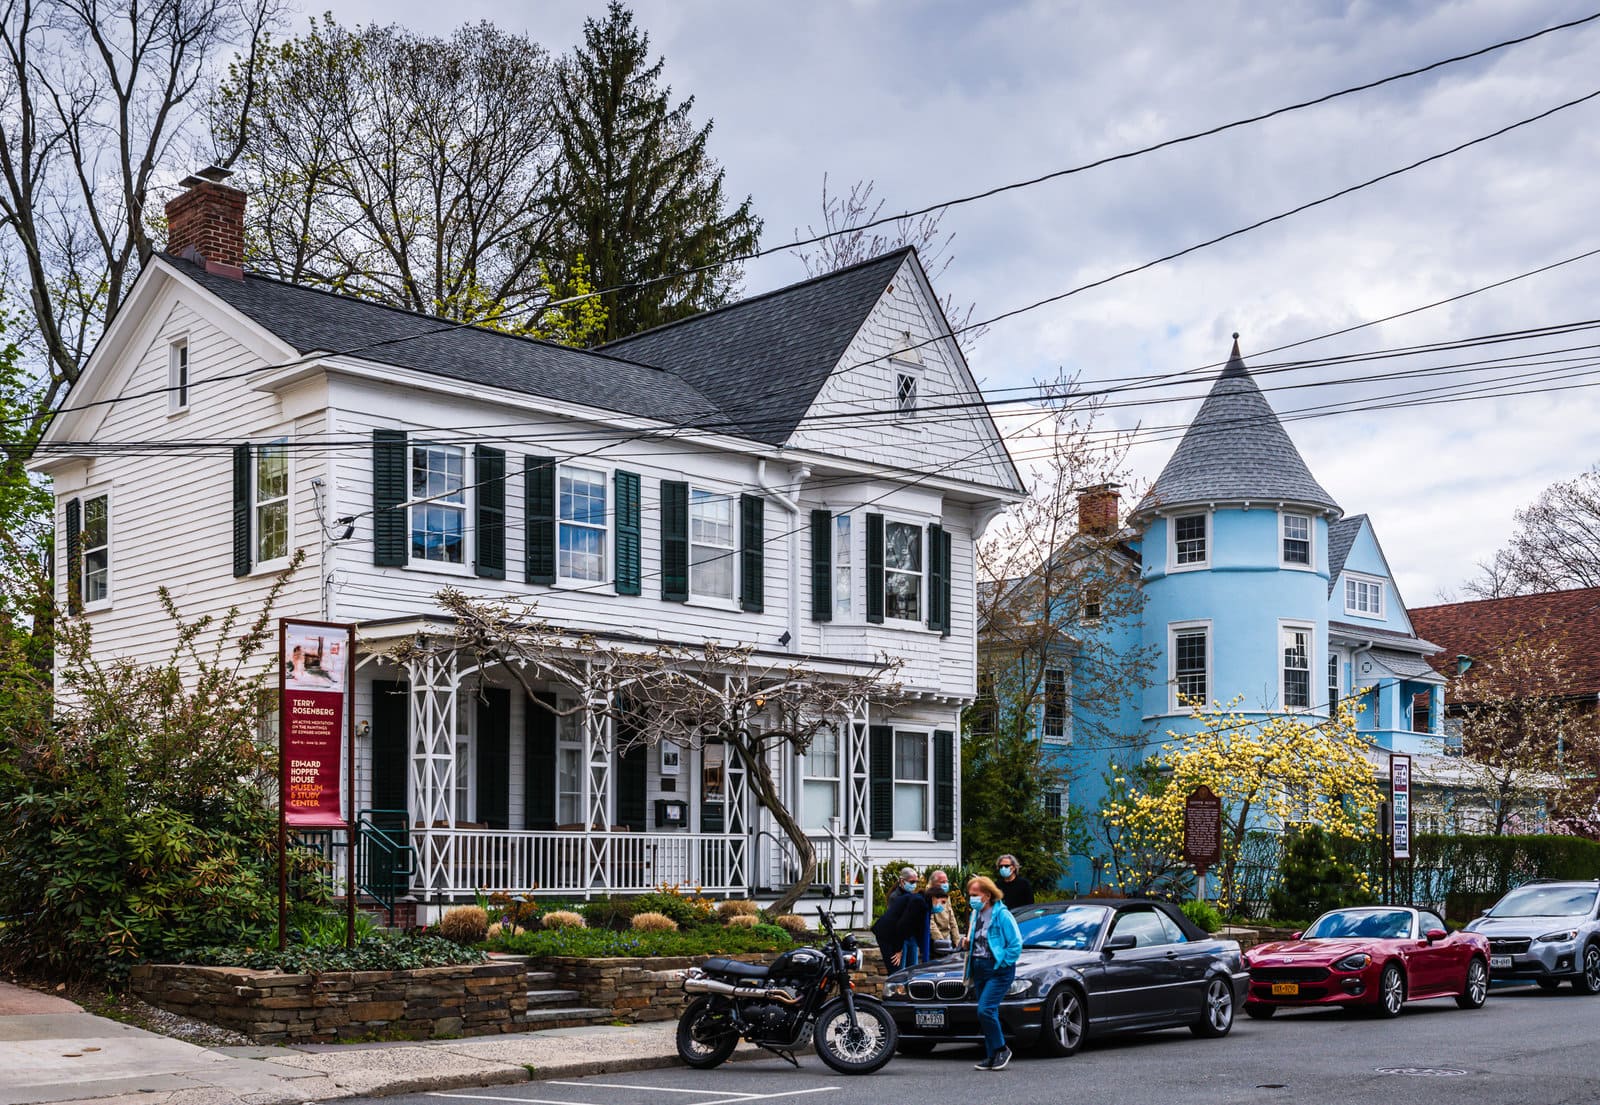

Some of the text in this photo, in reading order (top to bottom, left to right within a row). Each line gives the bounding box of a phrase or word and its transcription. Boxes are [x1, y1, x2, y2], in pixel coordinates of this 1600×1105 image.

[292, 699, 315, 707] TERRY
[292, 707, 335, 716] ROSENBERG
[290, 760, 321, 768] EDWARD
[290, 768, 320, 776] HOPPER
[290, 776, 315, 784] HOUSE
[290, 784, 323, 792] MUSEUM
[290, 799, 320, 807] CENTER
